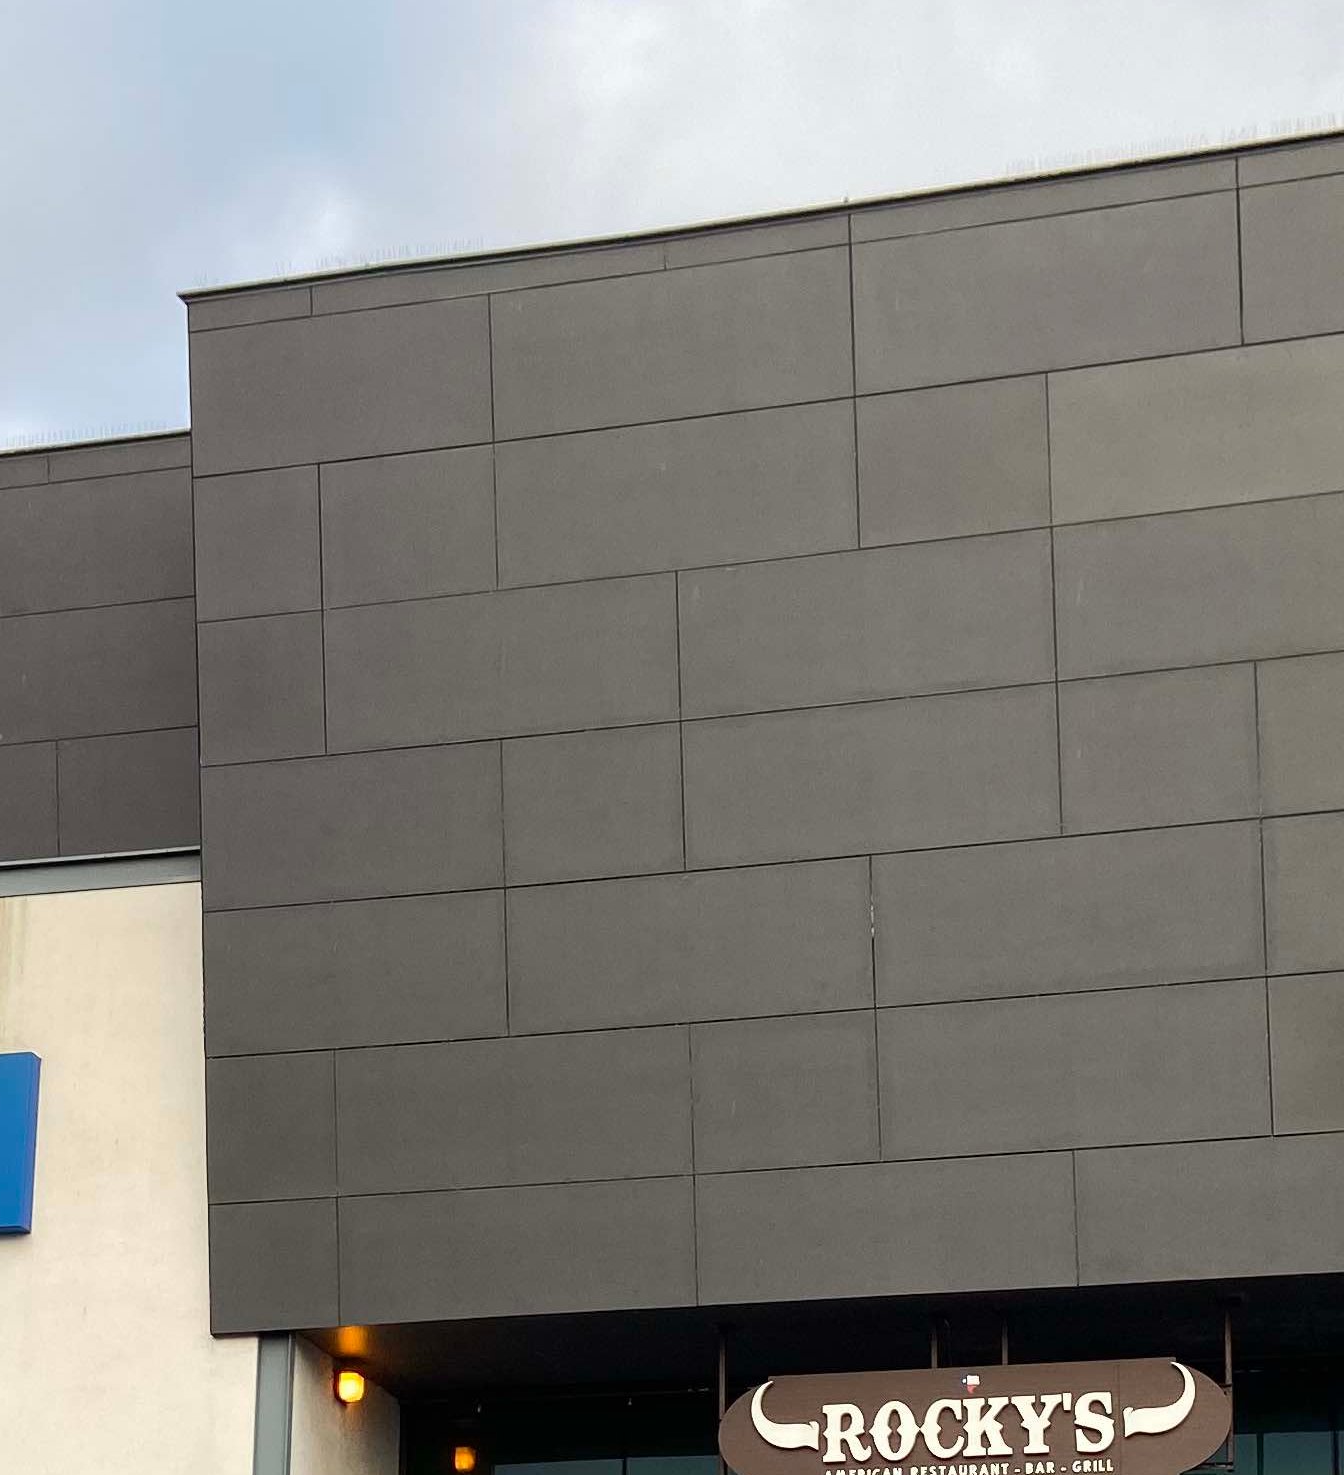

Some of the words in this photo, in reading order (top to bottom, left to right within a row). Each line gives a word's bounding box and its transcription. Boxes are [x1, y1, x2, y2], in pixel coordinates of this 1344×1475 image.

[821, 1391, 1116, 1464] ROCKY'S
[1024, 1460, 1056, 1475] BAR
[1071, 1458, 1115, 1474] GRILL
